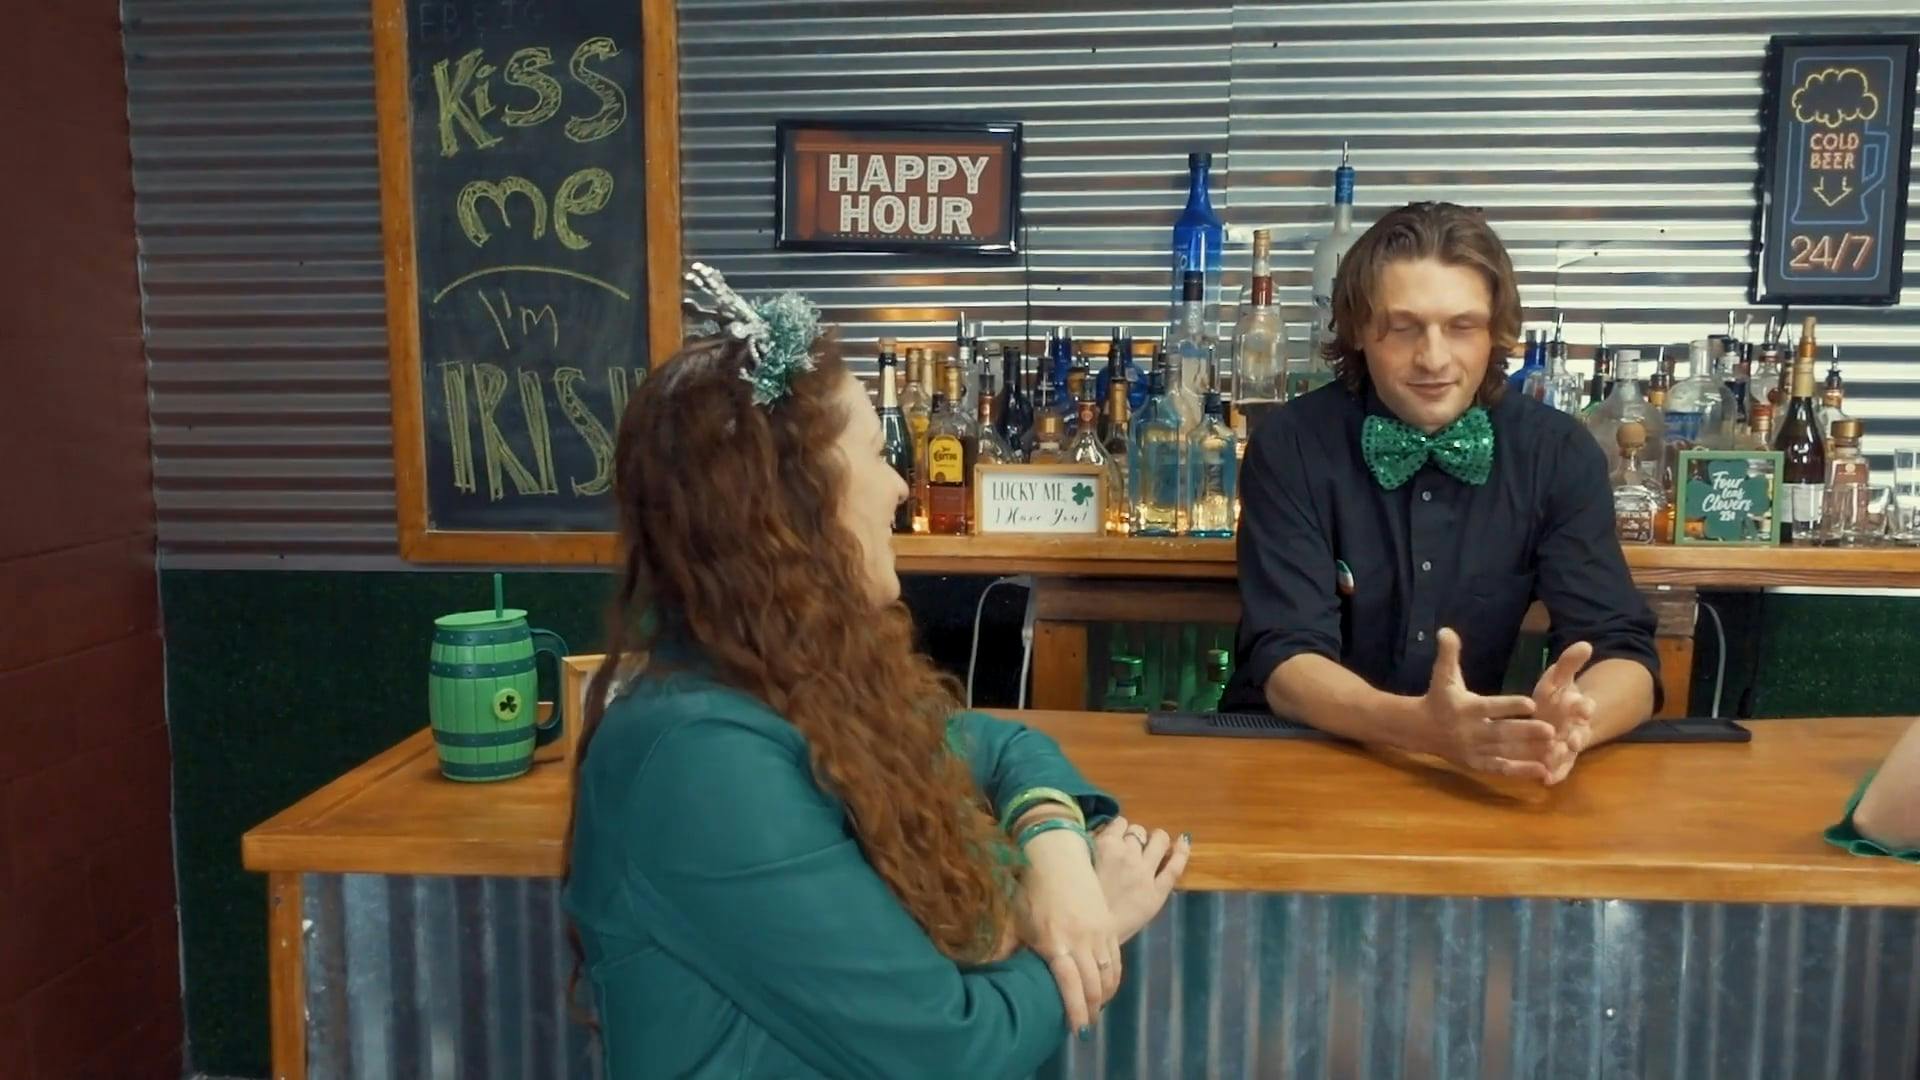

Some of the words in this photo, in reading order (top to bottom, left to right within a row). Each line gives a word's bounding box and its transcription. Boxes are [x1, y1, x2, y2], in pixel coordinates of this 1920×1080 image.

[1809, 132, 1860, 151] COLD
[1809, 151, 1855, 170] BEER
[828, 153, 990, 195] HAPPY
[456, 167, 614, 250] me
[839, 194, 974, 235] HOUR
[1789, 233, 1873, 272] 24/7
[1712, 470, 1745, 490] Four
[992, 481, 1038, 502] LUCKY
[1702, 493, 1753, 513] Clovers
